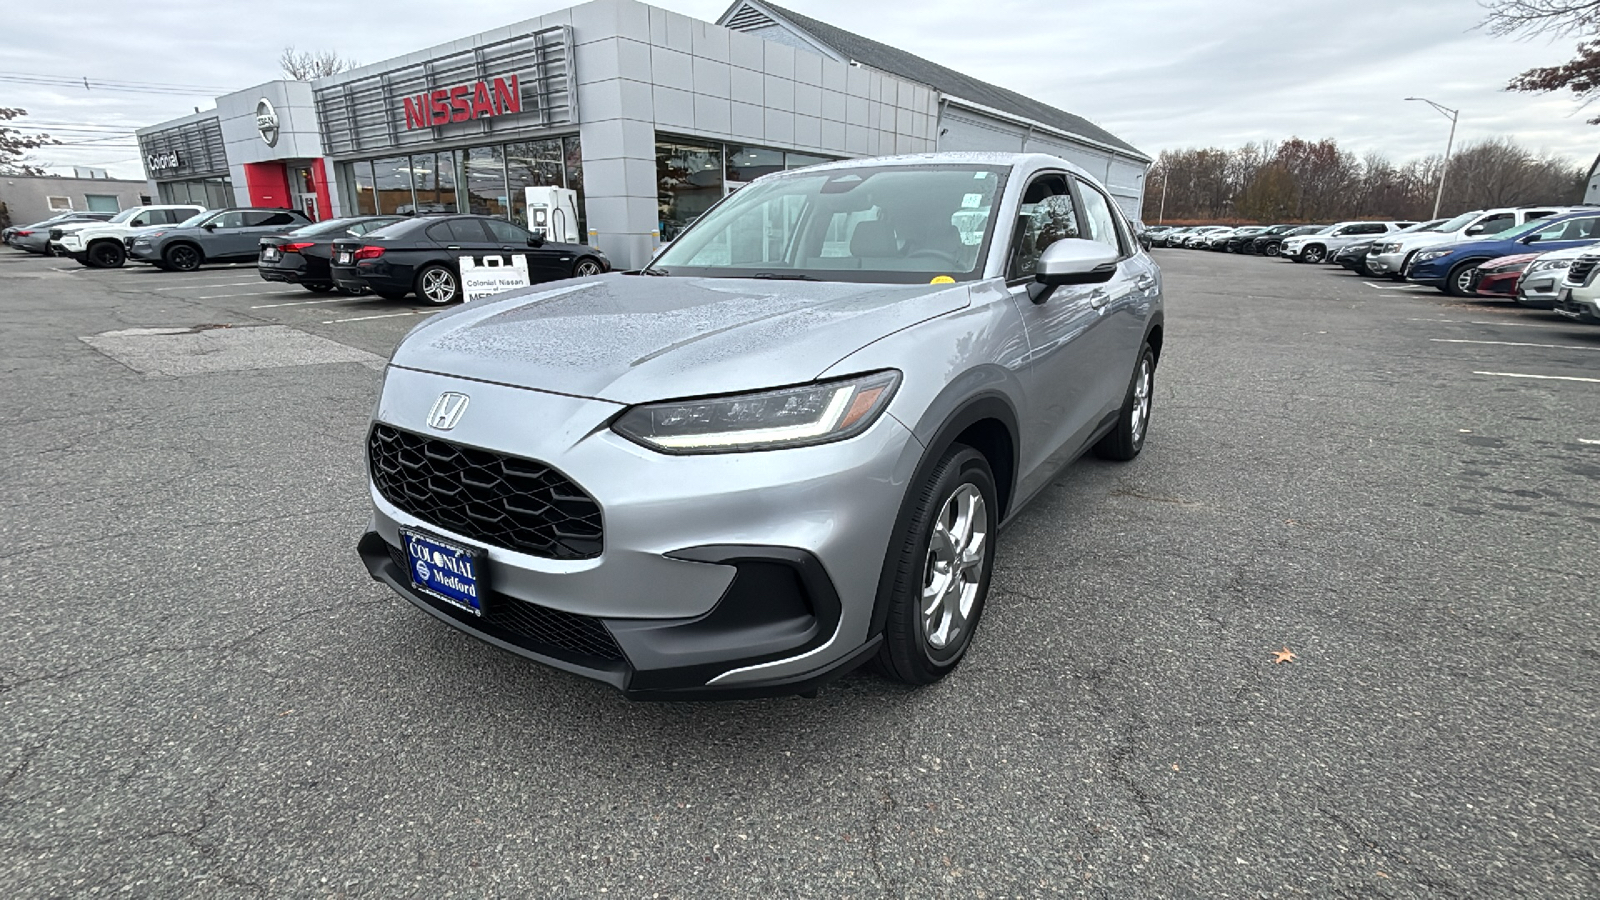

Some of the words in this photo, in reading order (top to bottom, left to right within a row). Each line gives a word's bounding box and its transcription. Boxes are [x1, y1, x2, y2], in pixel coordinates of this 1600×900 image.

[402, 74, 521, 131] NISSAN
[147, 150, 179, 171] Colonial
[466, 279, 496, 287] Colonial
[409, 542, 476, 580] COLONIAL
[433, 568, 477, 597] Medford
